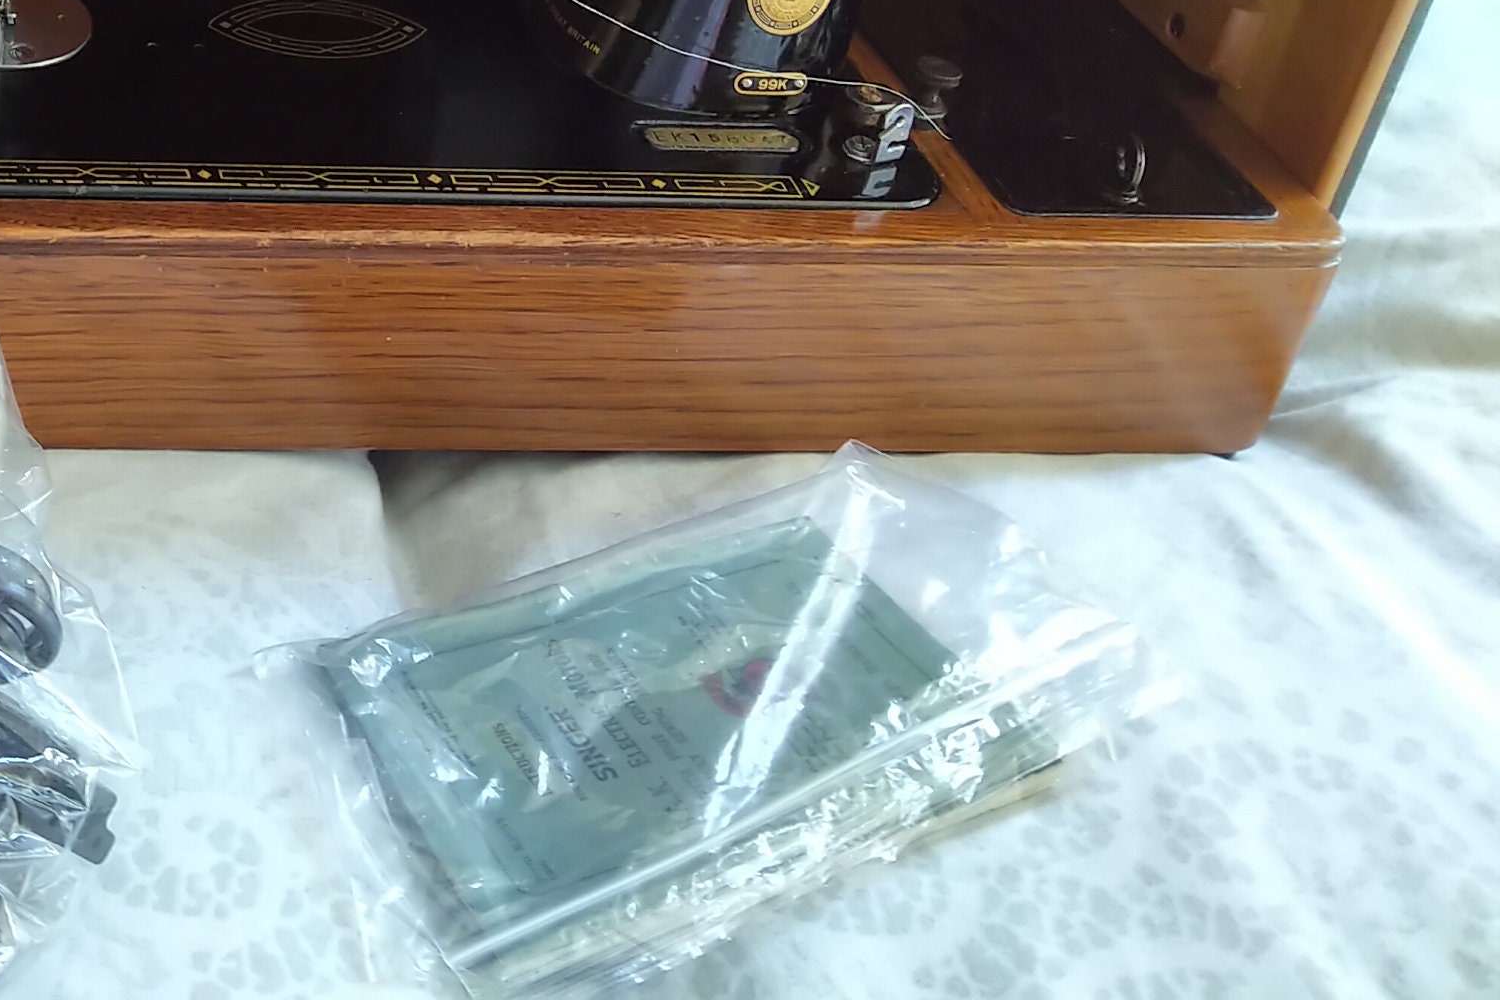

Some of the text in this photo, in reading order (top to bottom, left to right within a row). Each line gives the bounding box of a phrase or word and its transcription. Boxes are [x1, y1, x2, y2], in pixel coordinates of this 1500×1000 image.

[757, 78, 789, 91] 99K
[541, 639, 595, 697] MOTORS
[491, 721, 553, 797] ITRUCTIONS
[547, 706, 618, 780] SINGER
